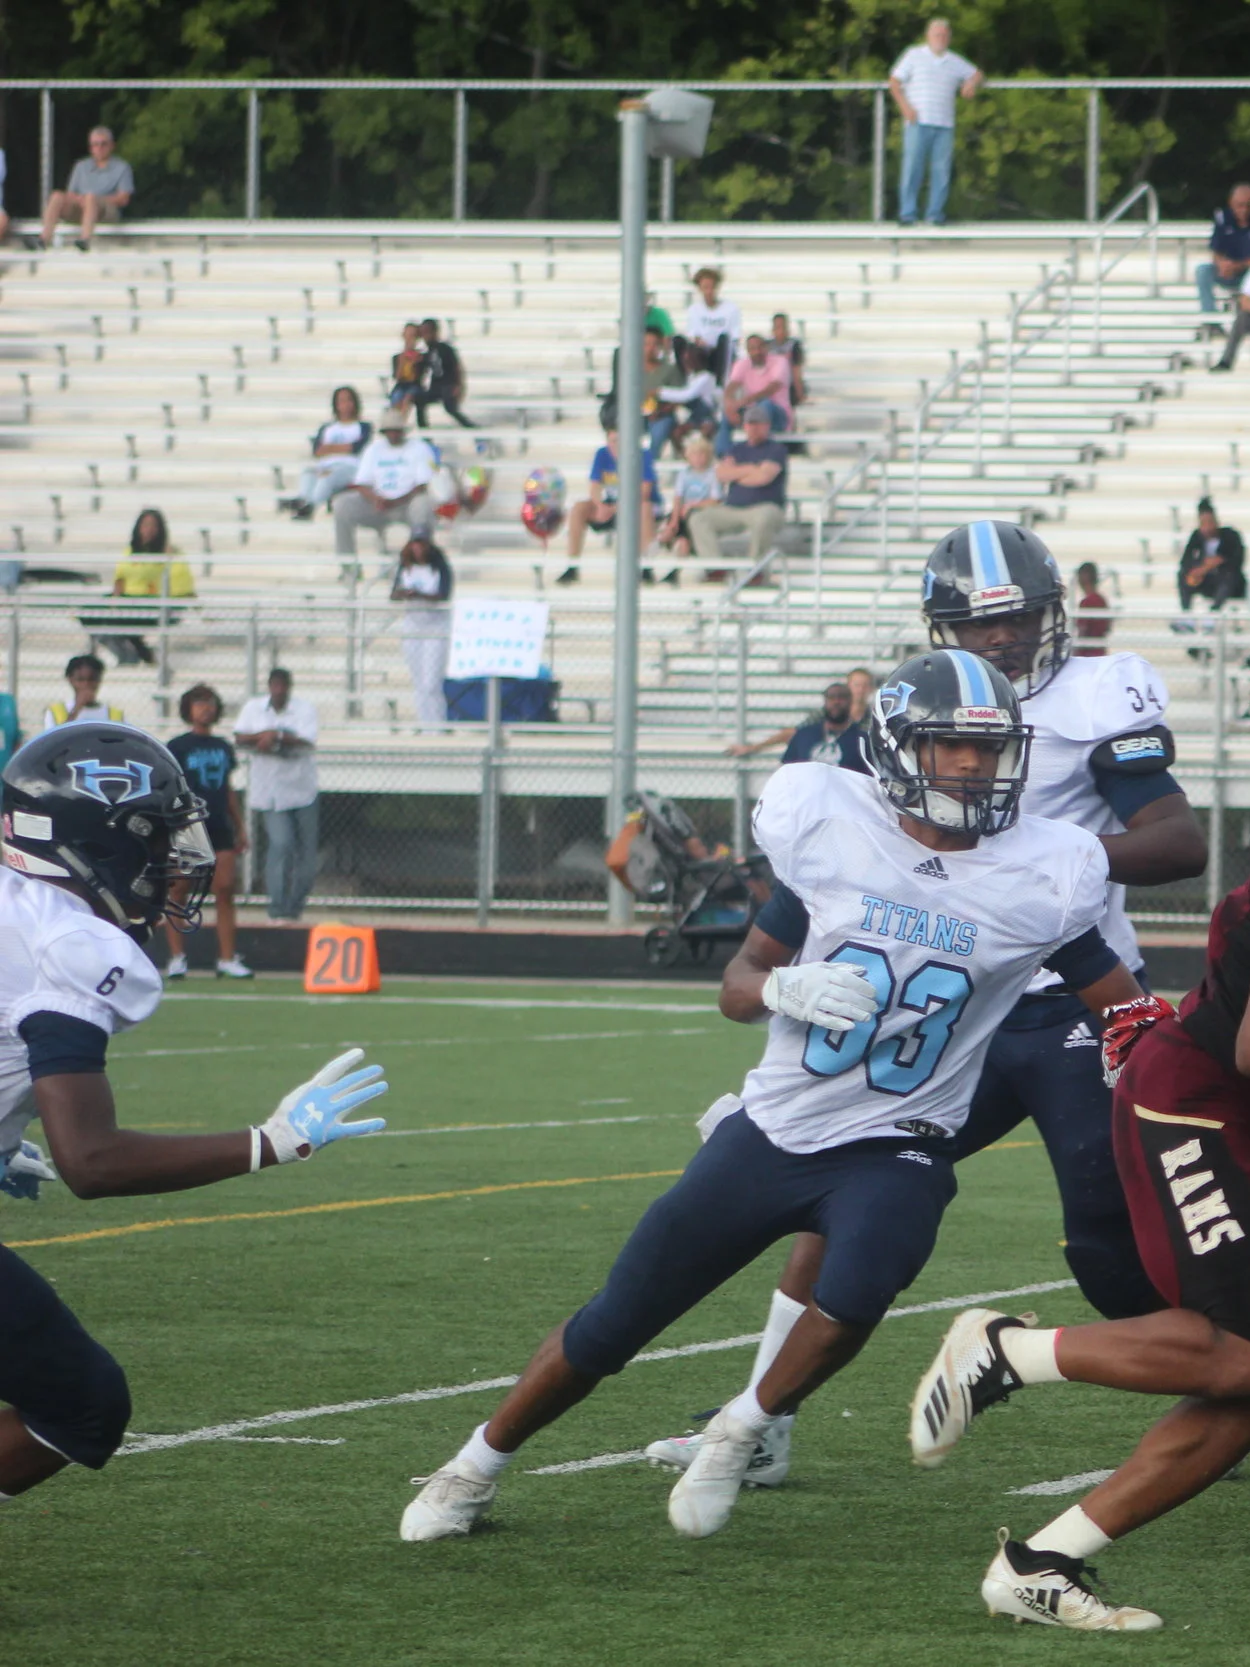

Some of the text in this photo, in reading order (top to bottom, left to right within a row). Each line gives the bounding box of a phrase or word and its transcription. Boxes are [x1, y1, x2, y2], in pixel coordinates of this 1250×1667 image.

[1126, 684, 1164, 713] 34
[967, 709, 998, 719] Riddell
[1111, 736, 1164, 754] GEAR
[913, 866, 950, 881] adidas
[860, 894, 979, 956] TITANS
[312, 936, 365, 985] 20
[96, 966, 124, 996] 6
[1063, 1039, 1099, 1049] adidas
[1160, 1138, 1246, 1256] RAMS
